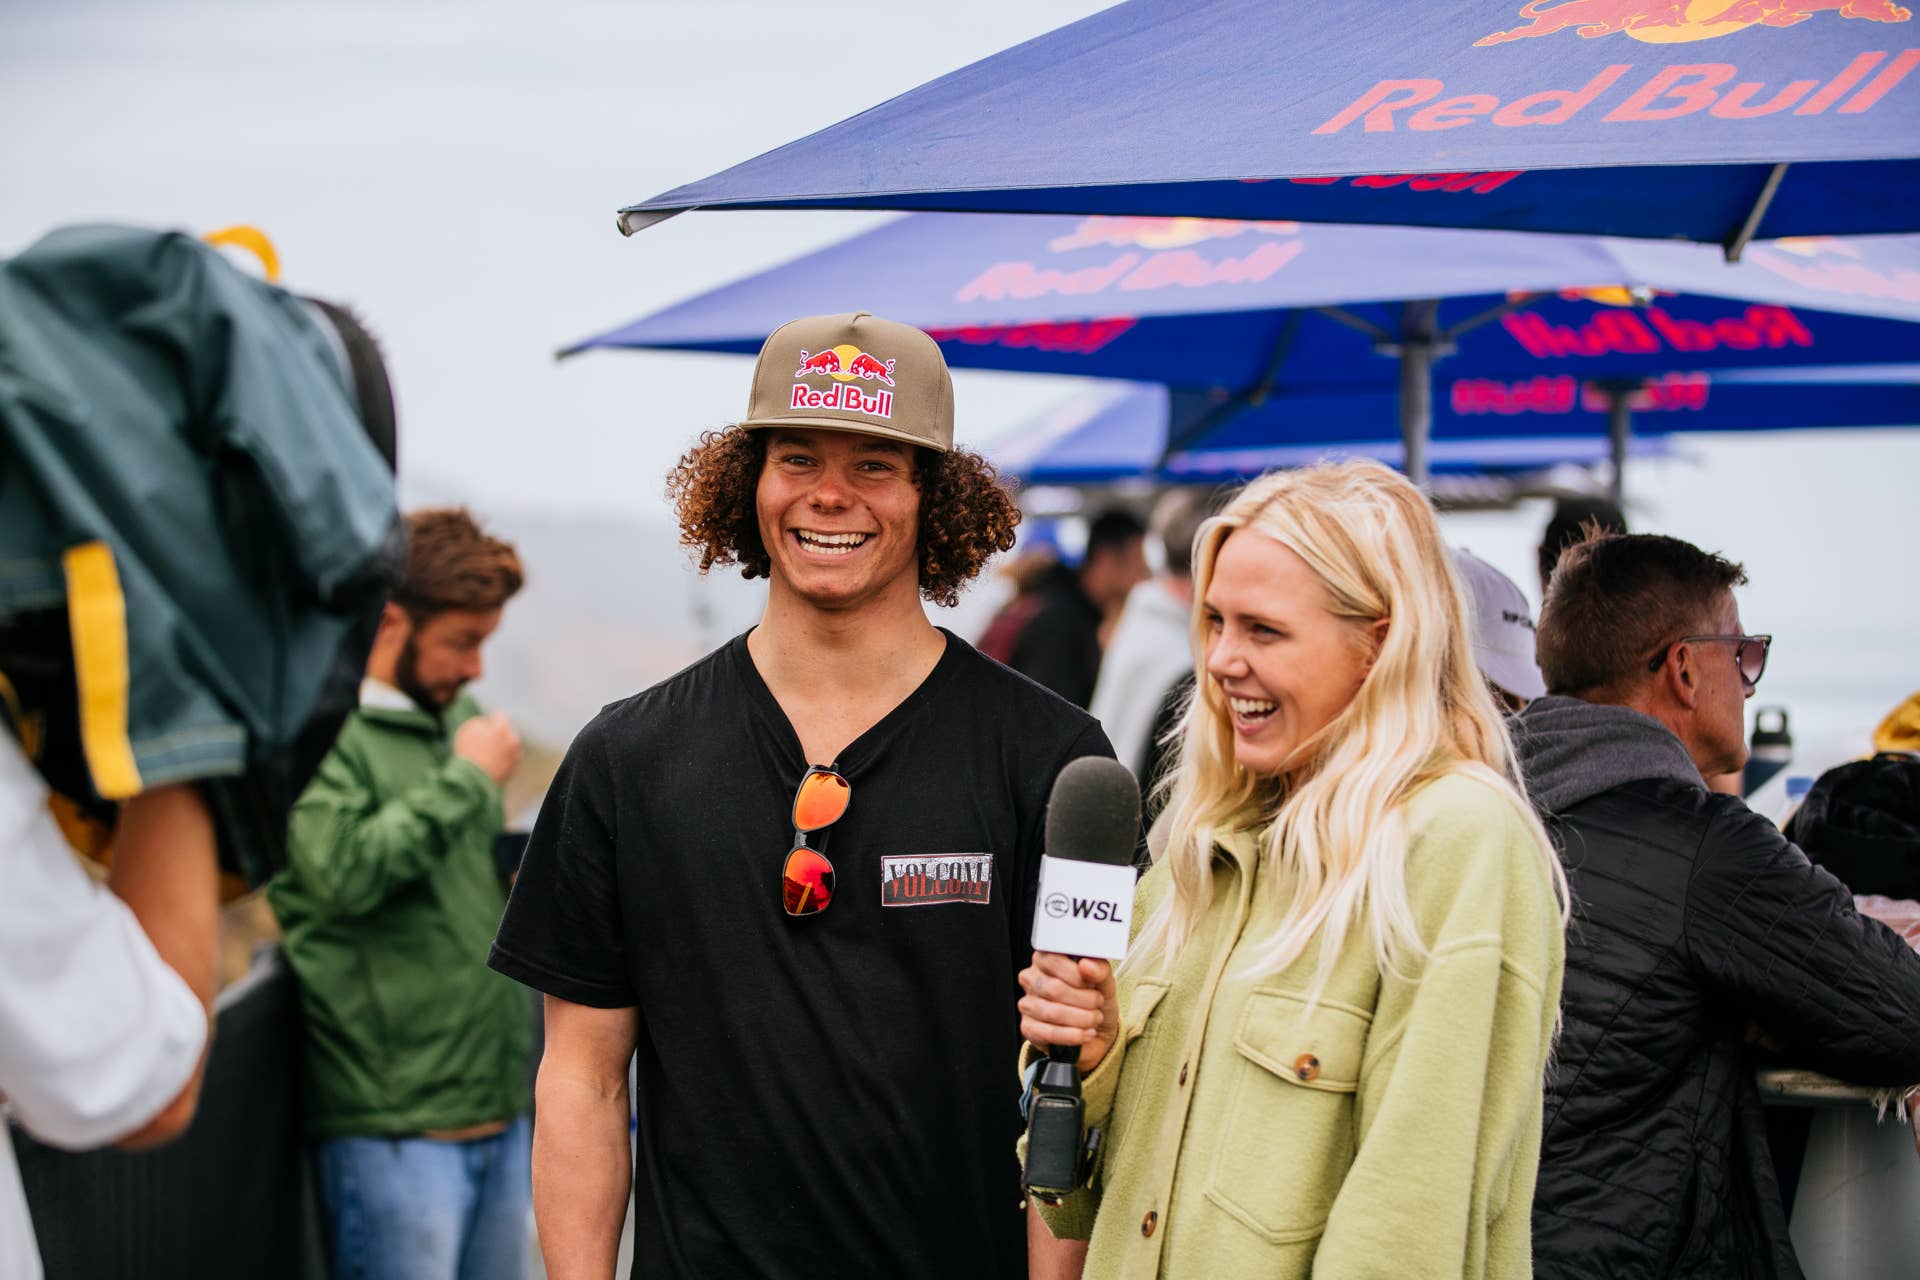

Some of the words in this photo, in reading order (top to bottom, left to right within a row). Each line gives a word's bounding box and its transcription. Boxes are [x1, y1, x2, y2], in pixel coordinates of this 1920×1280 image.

[1310, 63, 1634, 134] Red
[1602, 48, 1920, 122] Bull
[791, 384, 841, 408] Red
[845, 386, 892, 417] Bull
[890, 862, 983, 898] VOLCOM
[1072, 898, 1123, 923] WSL
